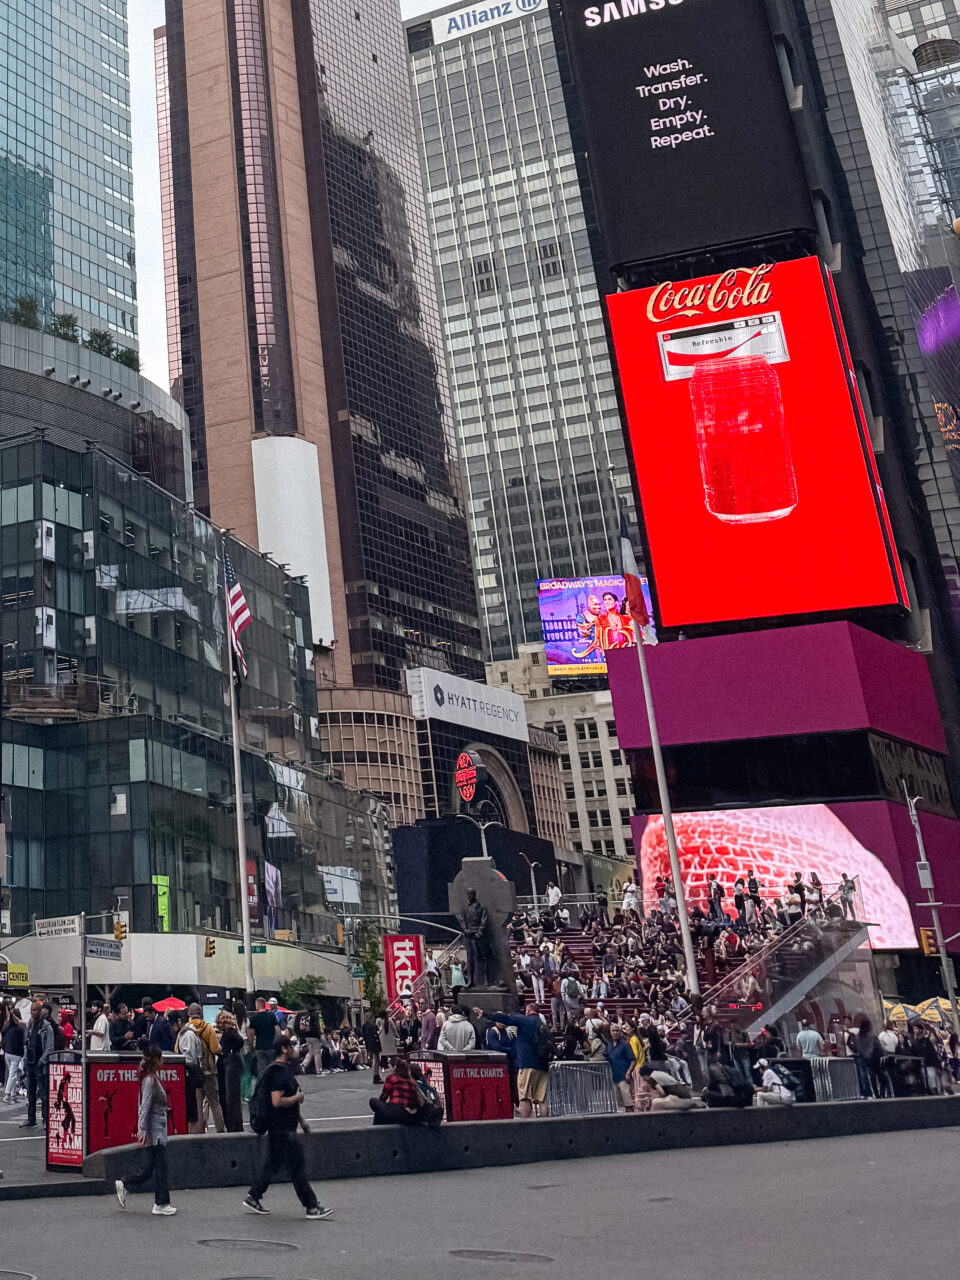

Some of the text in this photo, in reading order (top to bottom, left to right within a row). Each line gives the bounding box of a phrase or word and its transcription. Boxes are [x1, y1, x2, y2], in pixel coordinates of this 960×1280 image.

[446, 0, 513, 36] Allianz
[643, 58, 693, 78] Wash.
[635, 73, 709, 98] Transfer.
[659, 95, 692, 111] Dry.
[650, 109, 708, 131] Empty.
[650, 124, 715, 149] Repeat.
[646, 263, 776, 323] Coca-Cola
[539, 580, 594, 591] BROADWAY'S
[447, 692, 519, 722] HYATT REGENCY
[8, 972, 29, 983] CENTER
[392, 938, 417, 996] tkts
[96, 1069, 117, 1082] OFF.
[453, 1068, 466, 1079] OFF.
[480, 1068, 505, 1078] CHARTS.
[67, 1087, 82, 1103] BAD
